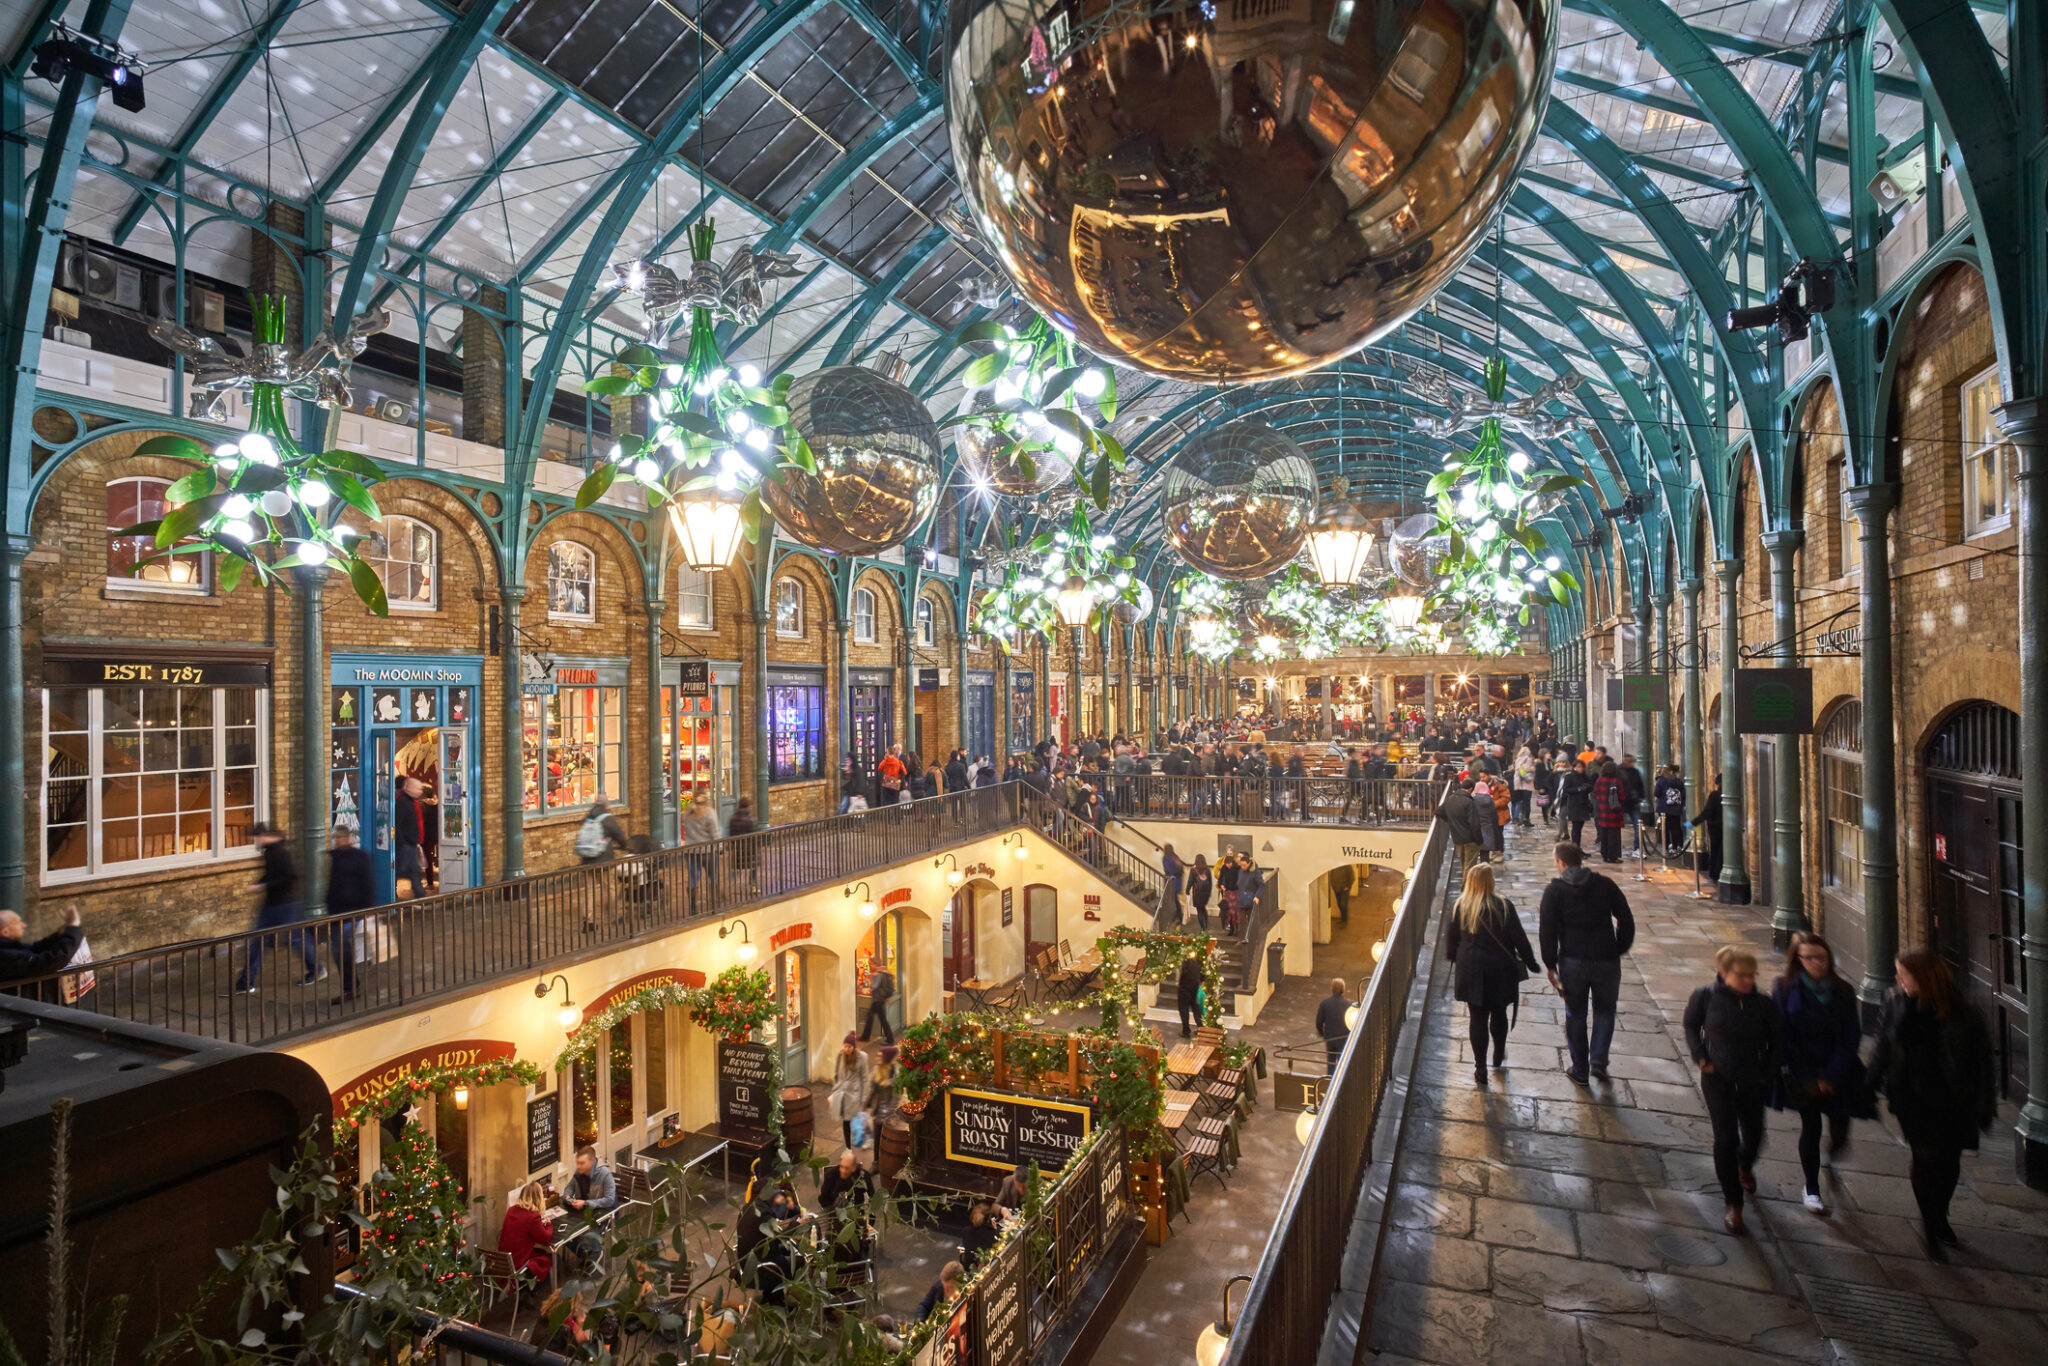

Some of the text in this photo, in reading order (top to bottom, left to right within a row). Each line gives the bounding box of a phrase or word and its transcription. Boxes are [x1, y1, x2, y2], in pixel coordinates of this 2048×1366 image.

[103, 664, 203, 684] EST. 1787
[355, 668, 462, 684] The MOOMIN Shop
[557, 668, 598, 684] PYLONES
[525, 684, 551, 694] MOOMIN
[683, 682, 706, 692] PYLONES
[1341, 846, 1393, 859] Whittard
[965, 862, 995, 879] Pie Shop
[881, 888, 912, 911] PYLONES
[769, 922, 813, 952] PYLONES
[609, 975, 673, 1007] WHISKIES
[724, 1049, 765, 1062] NO DRINKS
[729, 1057, 760, 1069] BEYOND
[340, 1048, 481, 1111] PUNCH & JUDY
[722, 1066, 768, 1080] THIS POINT
[534, 1104, 552, 1117] PUNCH
[537, 1110, 552, 1122] JUDY
[535, 1118, 549, 1130] FREE
[954, 1110, 1012, 1133] SUNDAY
[960, 1128, 1008, 1150] ROAST
[533, 1140, 552, 1156] HERE
[1101, 1161, 1122, 1204] PUB
[986, 1282, 1017, 1329] families
[985, 1301, 1019, 1351] welcome
[990, 1331, 1014, 1366] here
